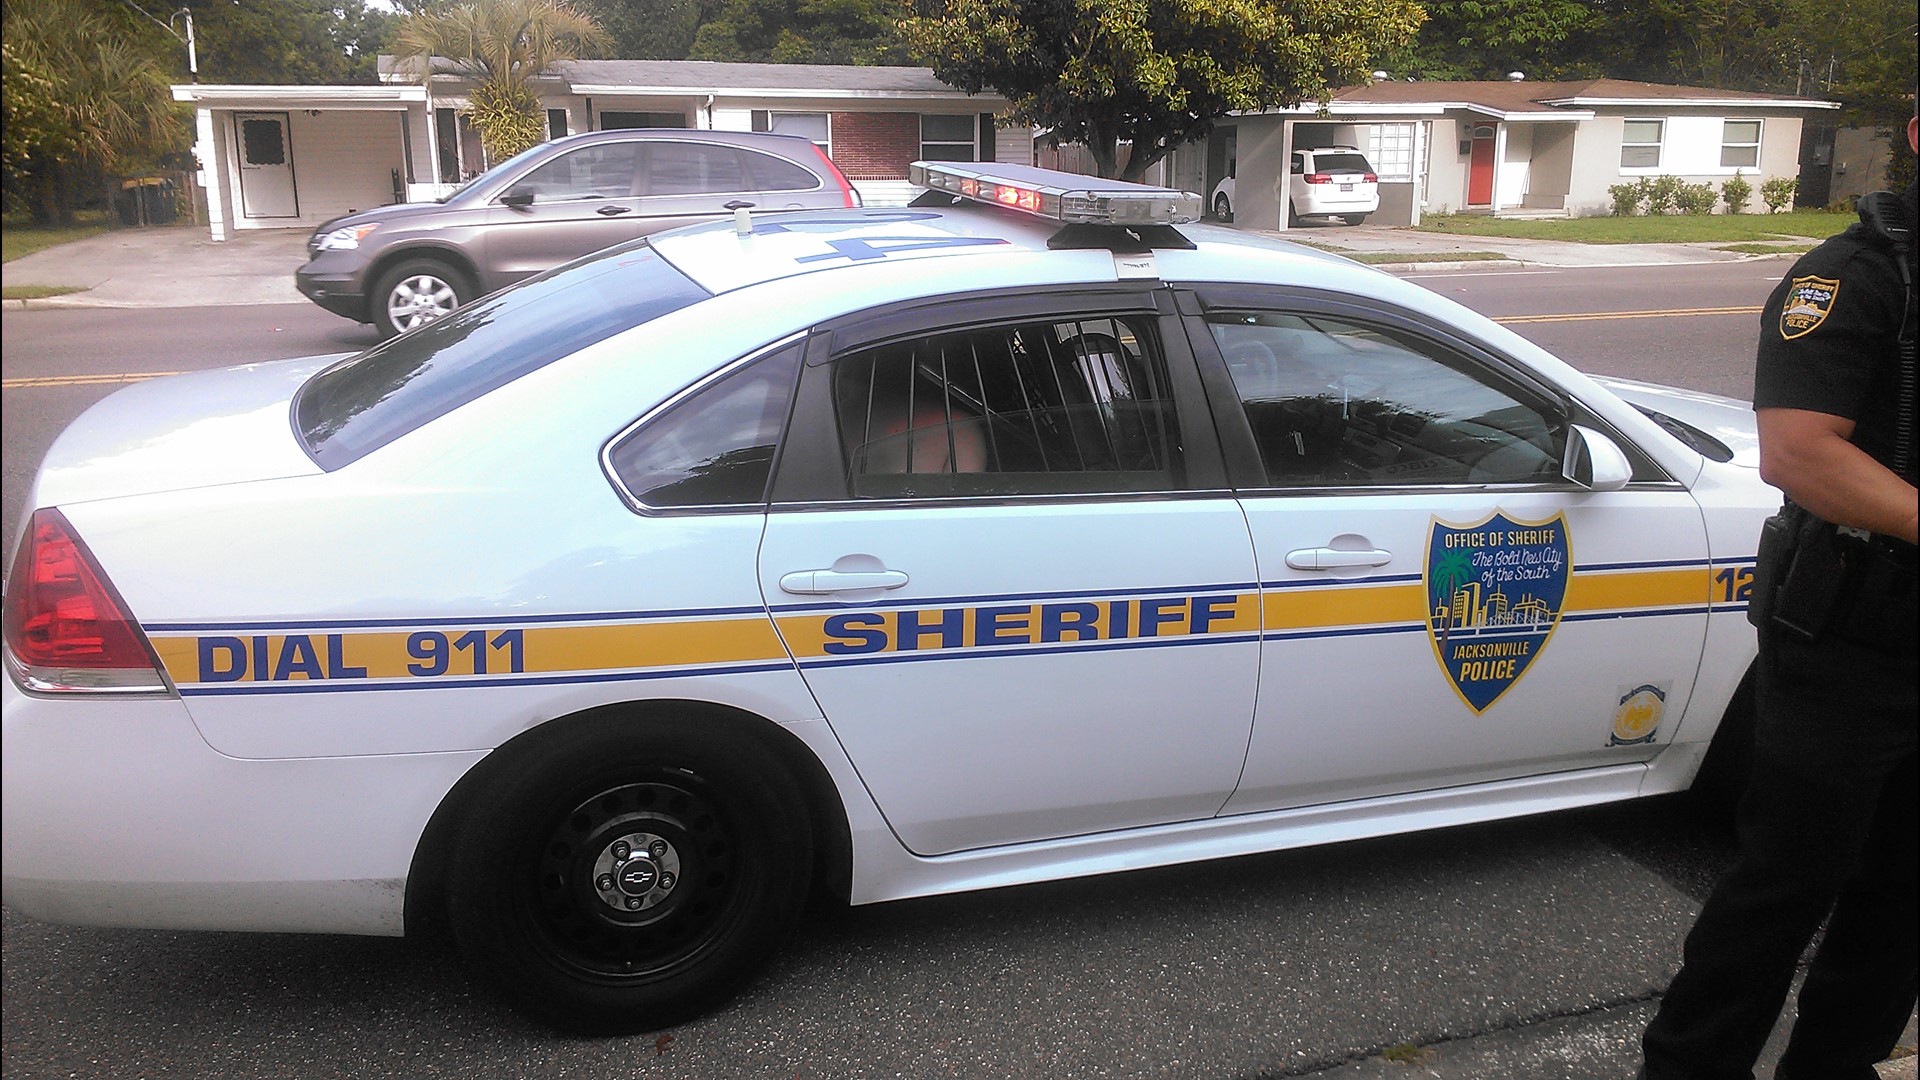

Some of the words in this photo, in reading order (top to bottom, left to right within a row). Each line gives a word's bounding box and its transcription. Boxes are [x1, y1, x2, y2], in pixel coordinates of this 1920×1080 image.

[1444, 532, 1486, 549] OFFICE
[1489, 531, 1504, 547] OF
[1508, 529, 1556, 546] SHERIFF
[1472, 551, 1493, 567] The
[1494, 549, 1520, 567] Bold
[1521, 548, 1542, 565] New
[1542, 546, 1563, 572] City
[1481, 568, 1496, 588] of
[1496, 567, 1514, 582] the
[1514, 565, 1551, 581] South
[822, 594, 1238, 655] SHERIFF
[197, 634, 368, 683] DIAL
[406, 628, 525, 677] 911
[1453, 641, 1530, 660] JACKSONVILLE
[1460, 659, 1516, 682] POLICE
